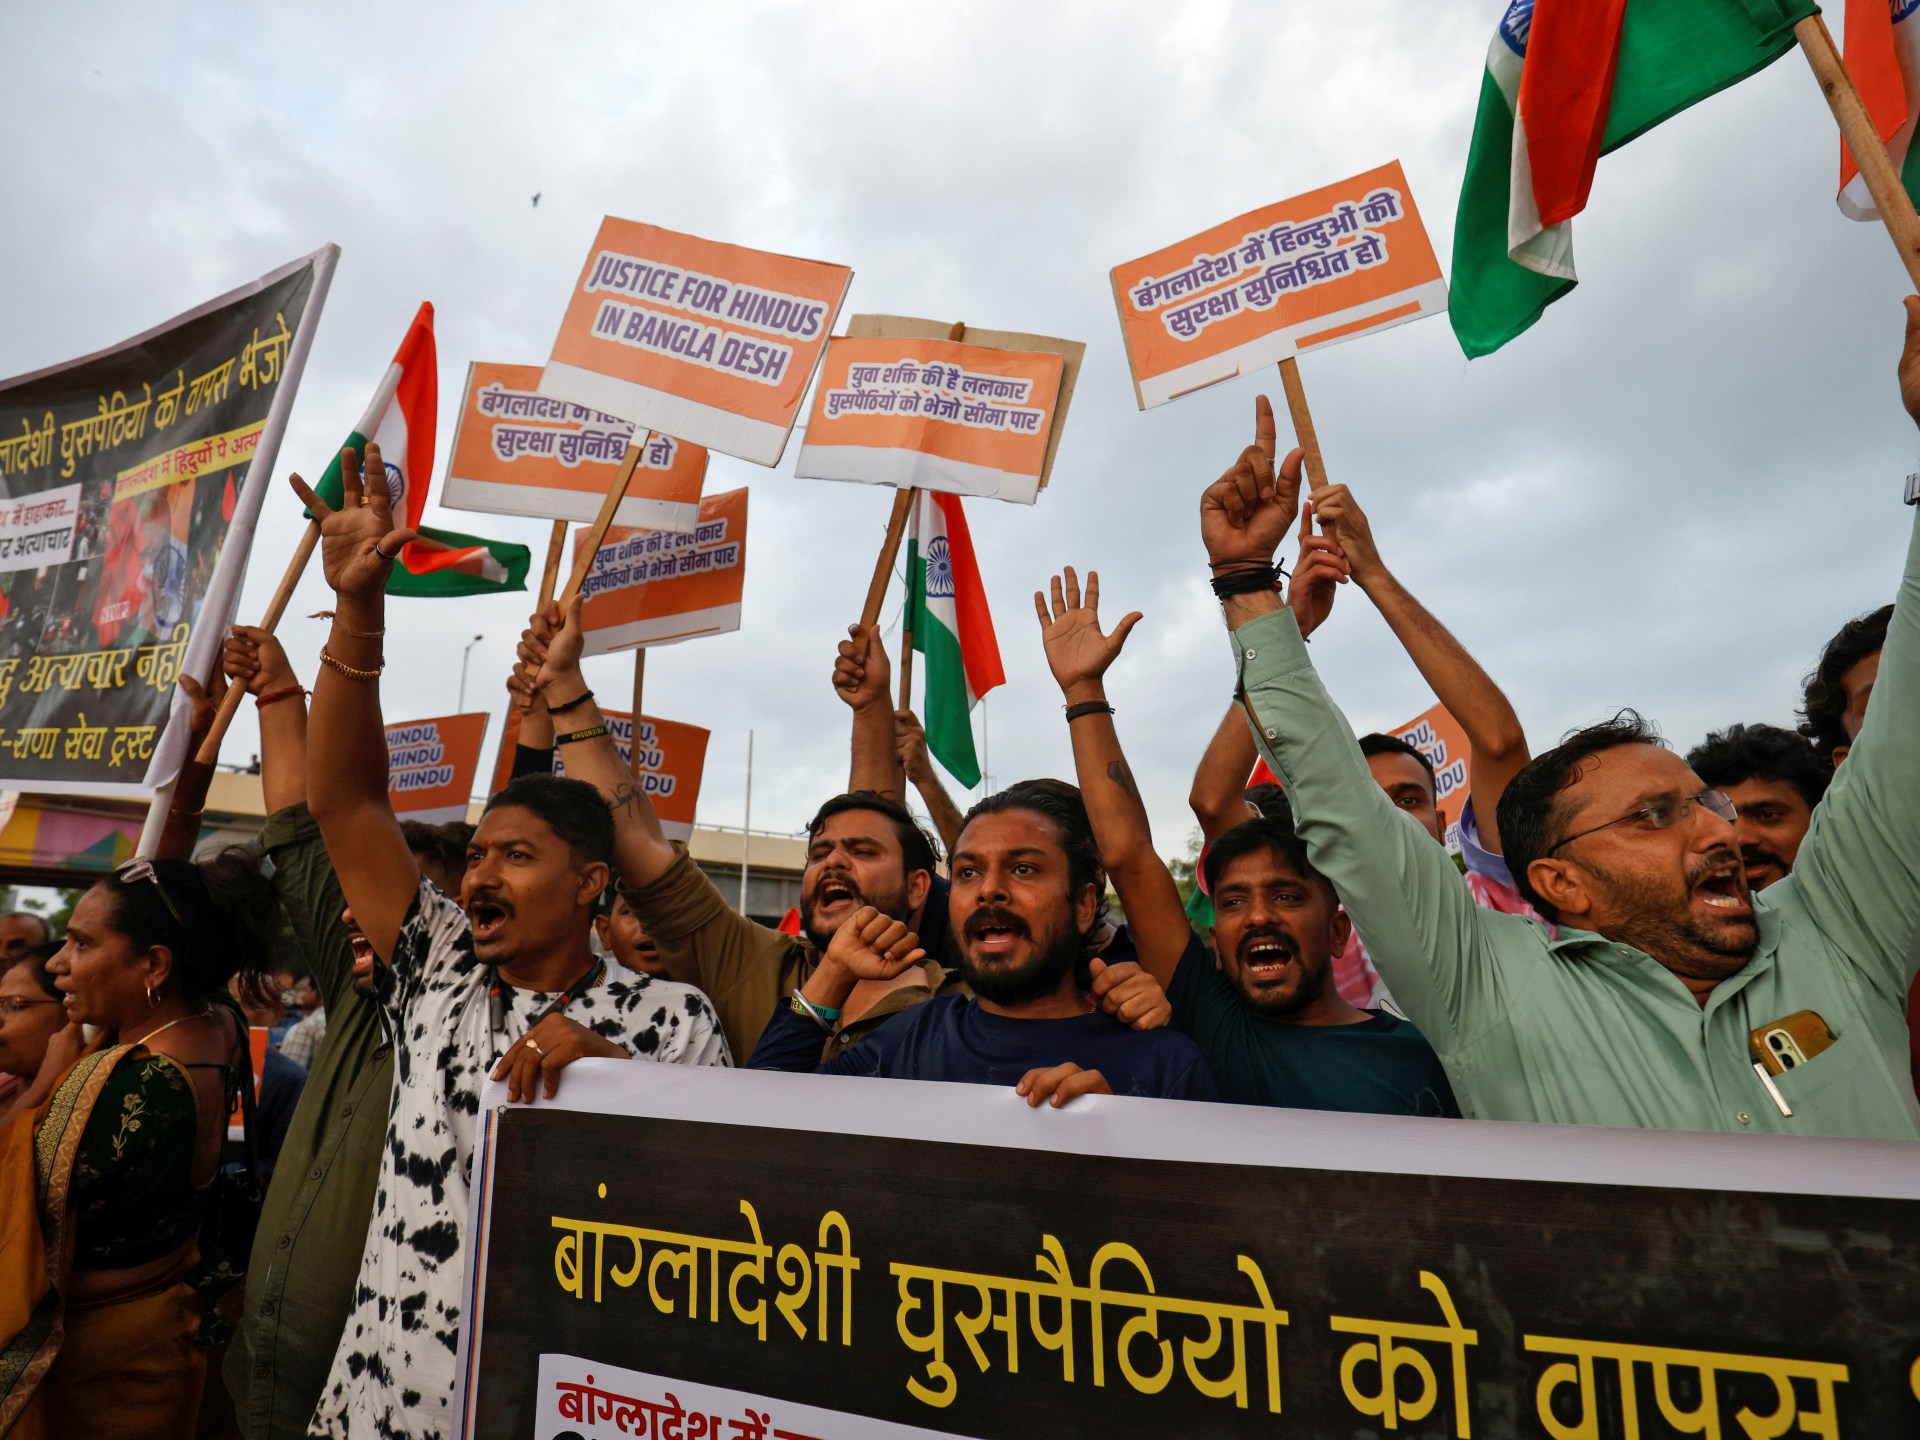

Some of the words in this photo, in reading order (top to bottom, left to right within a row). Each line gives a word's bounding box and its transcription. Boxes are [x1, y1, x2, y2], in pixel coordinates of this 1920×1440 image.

[1134, 252, 1238, 307] बंगलादेश
[1239, 233, 1266, 264] में
[1268, 206, 1358, 255] हिन्दुओं
[1359, 192, 1398, 223] की
[588, 256, 679, 300] JUSTICE
[677, 277, 728, 313] FOR
[727, 289, 823, 335] HINDUS
[1167, 288, 1240, 336] सुरक्षा
[1241, 250, 1350, 306] सुनिश्चित
[1351, 236, 1383, 264] हो
[596, 305, 624, 335] IN
[623, 312, 716, 362] BANGLA
[718, 336, 787, 380] DESH
[154, 370, 184, 430] को
[185, 357, 236, 415] वापस
[239, 312, 292, 390] भेजो
[852, 366, 881, 387] युवा
[882, 363, 920, 384] शक्ति
[921, 365, 945, 387] की
[946, 368, 960, 390] है
[962, 376, 1028, 400] ललकार
[829, 389, 900, 415] घुसपैठियों
[899, 390, 921, 412] को
[923, 394, 961, 420] भेजो
[963, 401, 1009, 426] सीमा
[1010, 410, 1040, 430] पार
[496, 428, 556, 457] सुरक्षा
[650, 437, 673, 466] हो
[14, 527, 72, 556] अत्याचार
[596, 546, 617, 569] युवा
[618, 538, 644, 560] शक्ति
[646, 532, 663, 553] की
[632, 561, 648, 582] को
[650, 554, 677, 577] भेजो
[679, 551, 711, 573] सीमा
[714, 546, 736, 566] पार
[19, 647, 131, 692] अत्याचार
[64, 712, 107, 760] सेवा
[108, 725, 156, 768] ट्रस्ट
[390, 747, 442, 768] HINDU
[398, 768, 451, 788] HINDU
[551, 1183, 861, 1347] बांग्लादेशी
[890, 1233, 1290, 1414] घुसपैठियो
[1330, 1270, 1478, 1440] को
[1523, 1334, 1850, 1440] वापस
